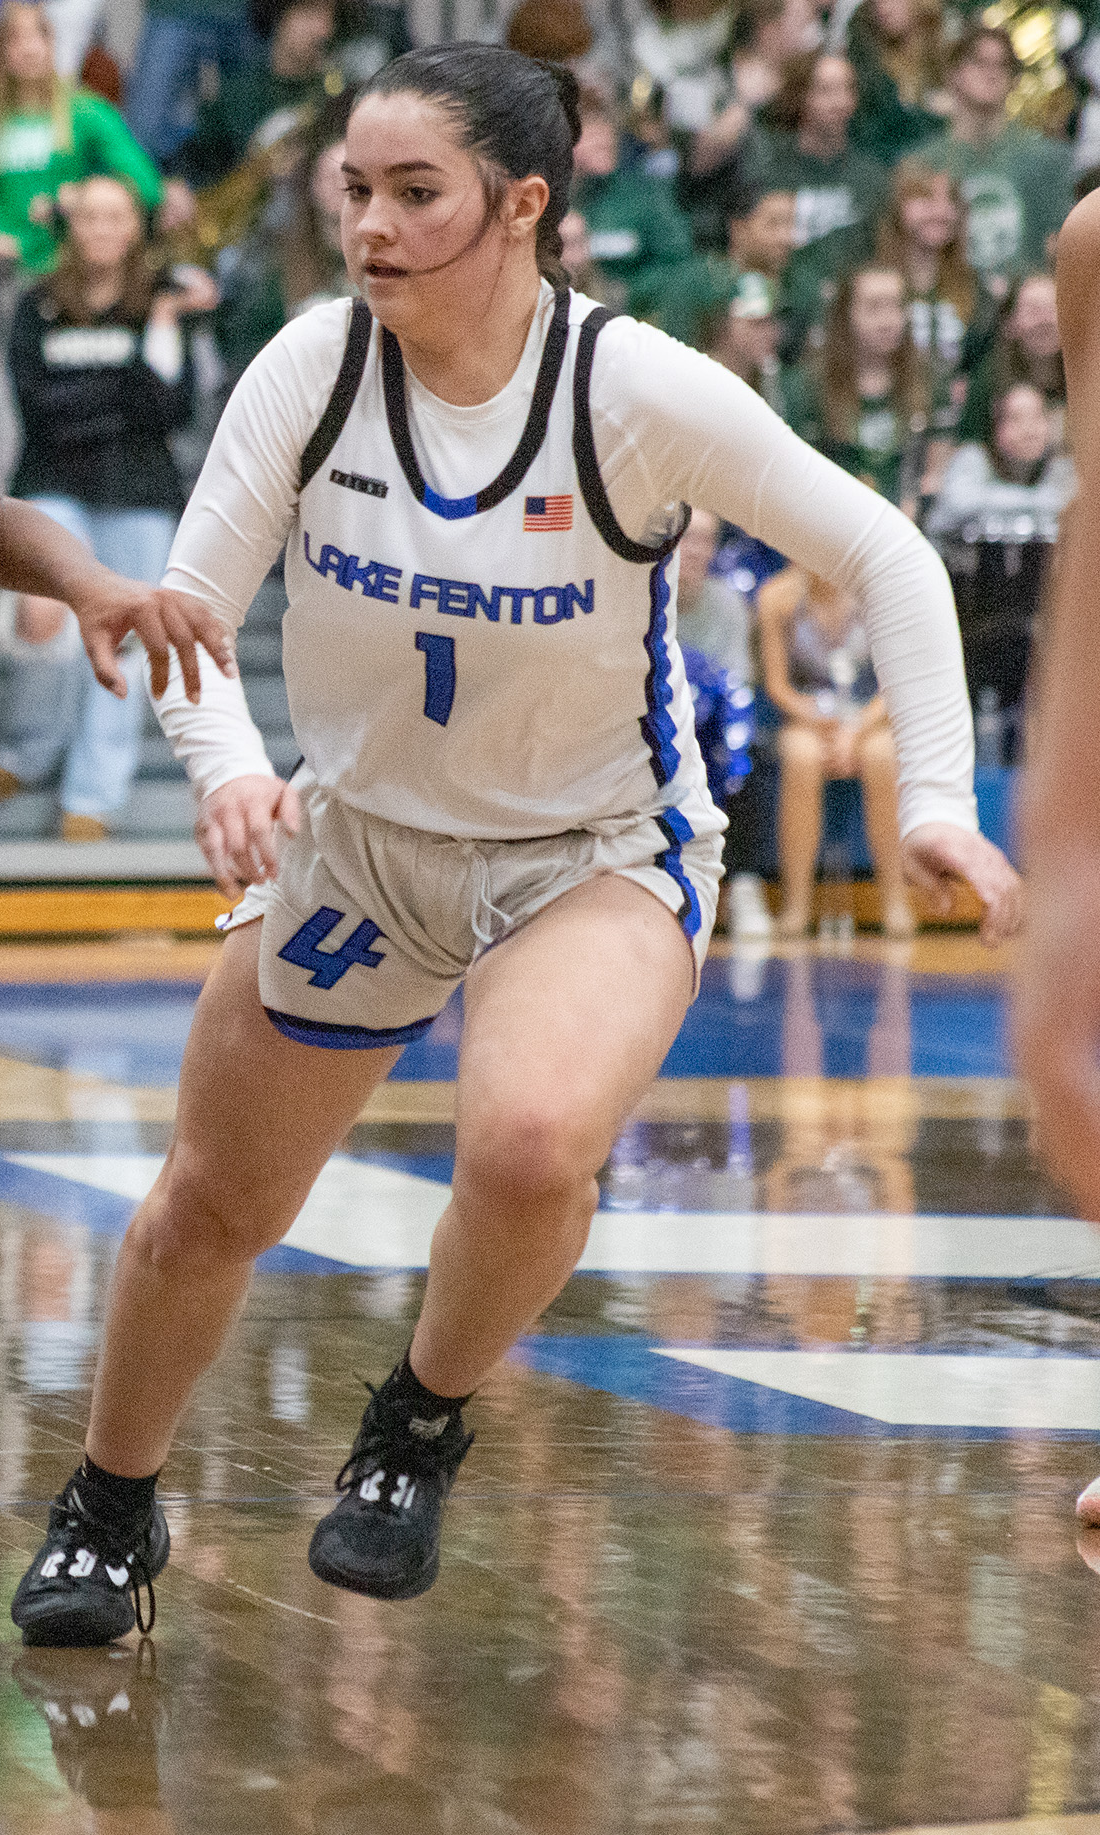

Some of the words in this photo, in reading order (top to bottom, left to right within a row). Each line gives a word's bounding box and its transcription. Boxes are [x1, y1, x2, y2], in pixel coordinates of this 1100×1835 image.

[304, 531, 403, 605] LAKE
[409, 573, 595, 626] FENTON
[415, 631, 457, 728] 1
[277, 905, 387, 990] 4
